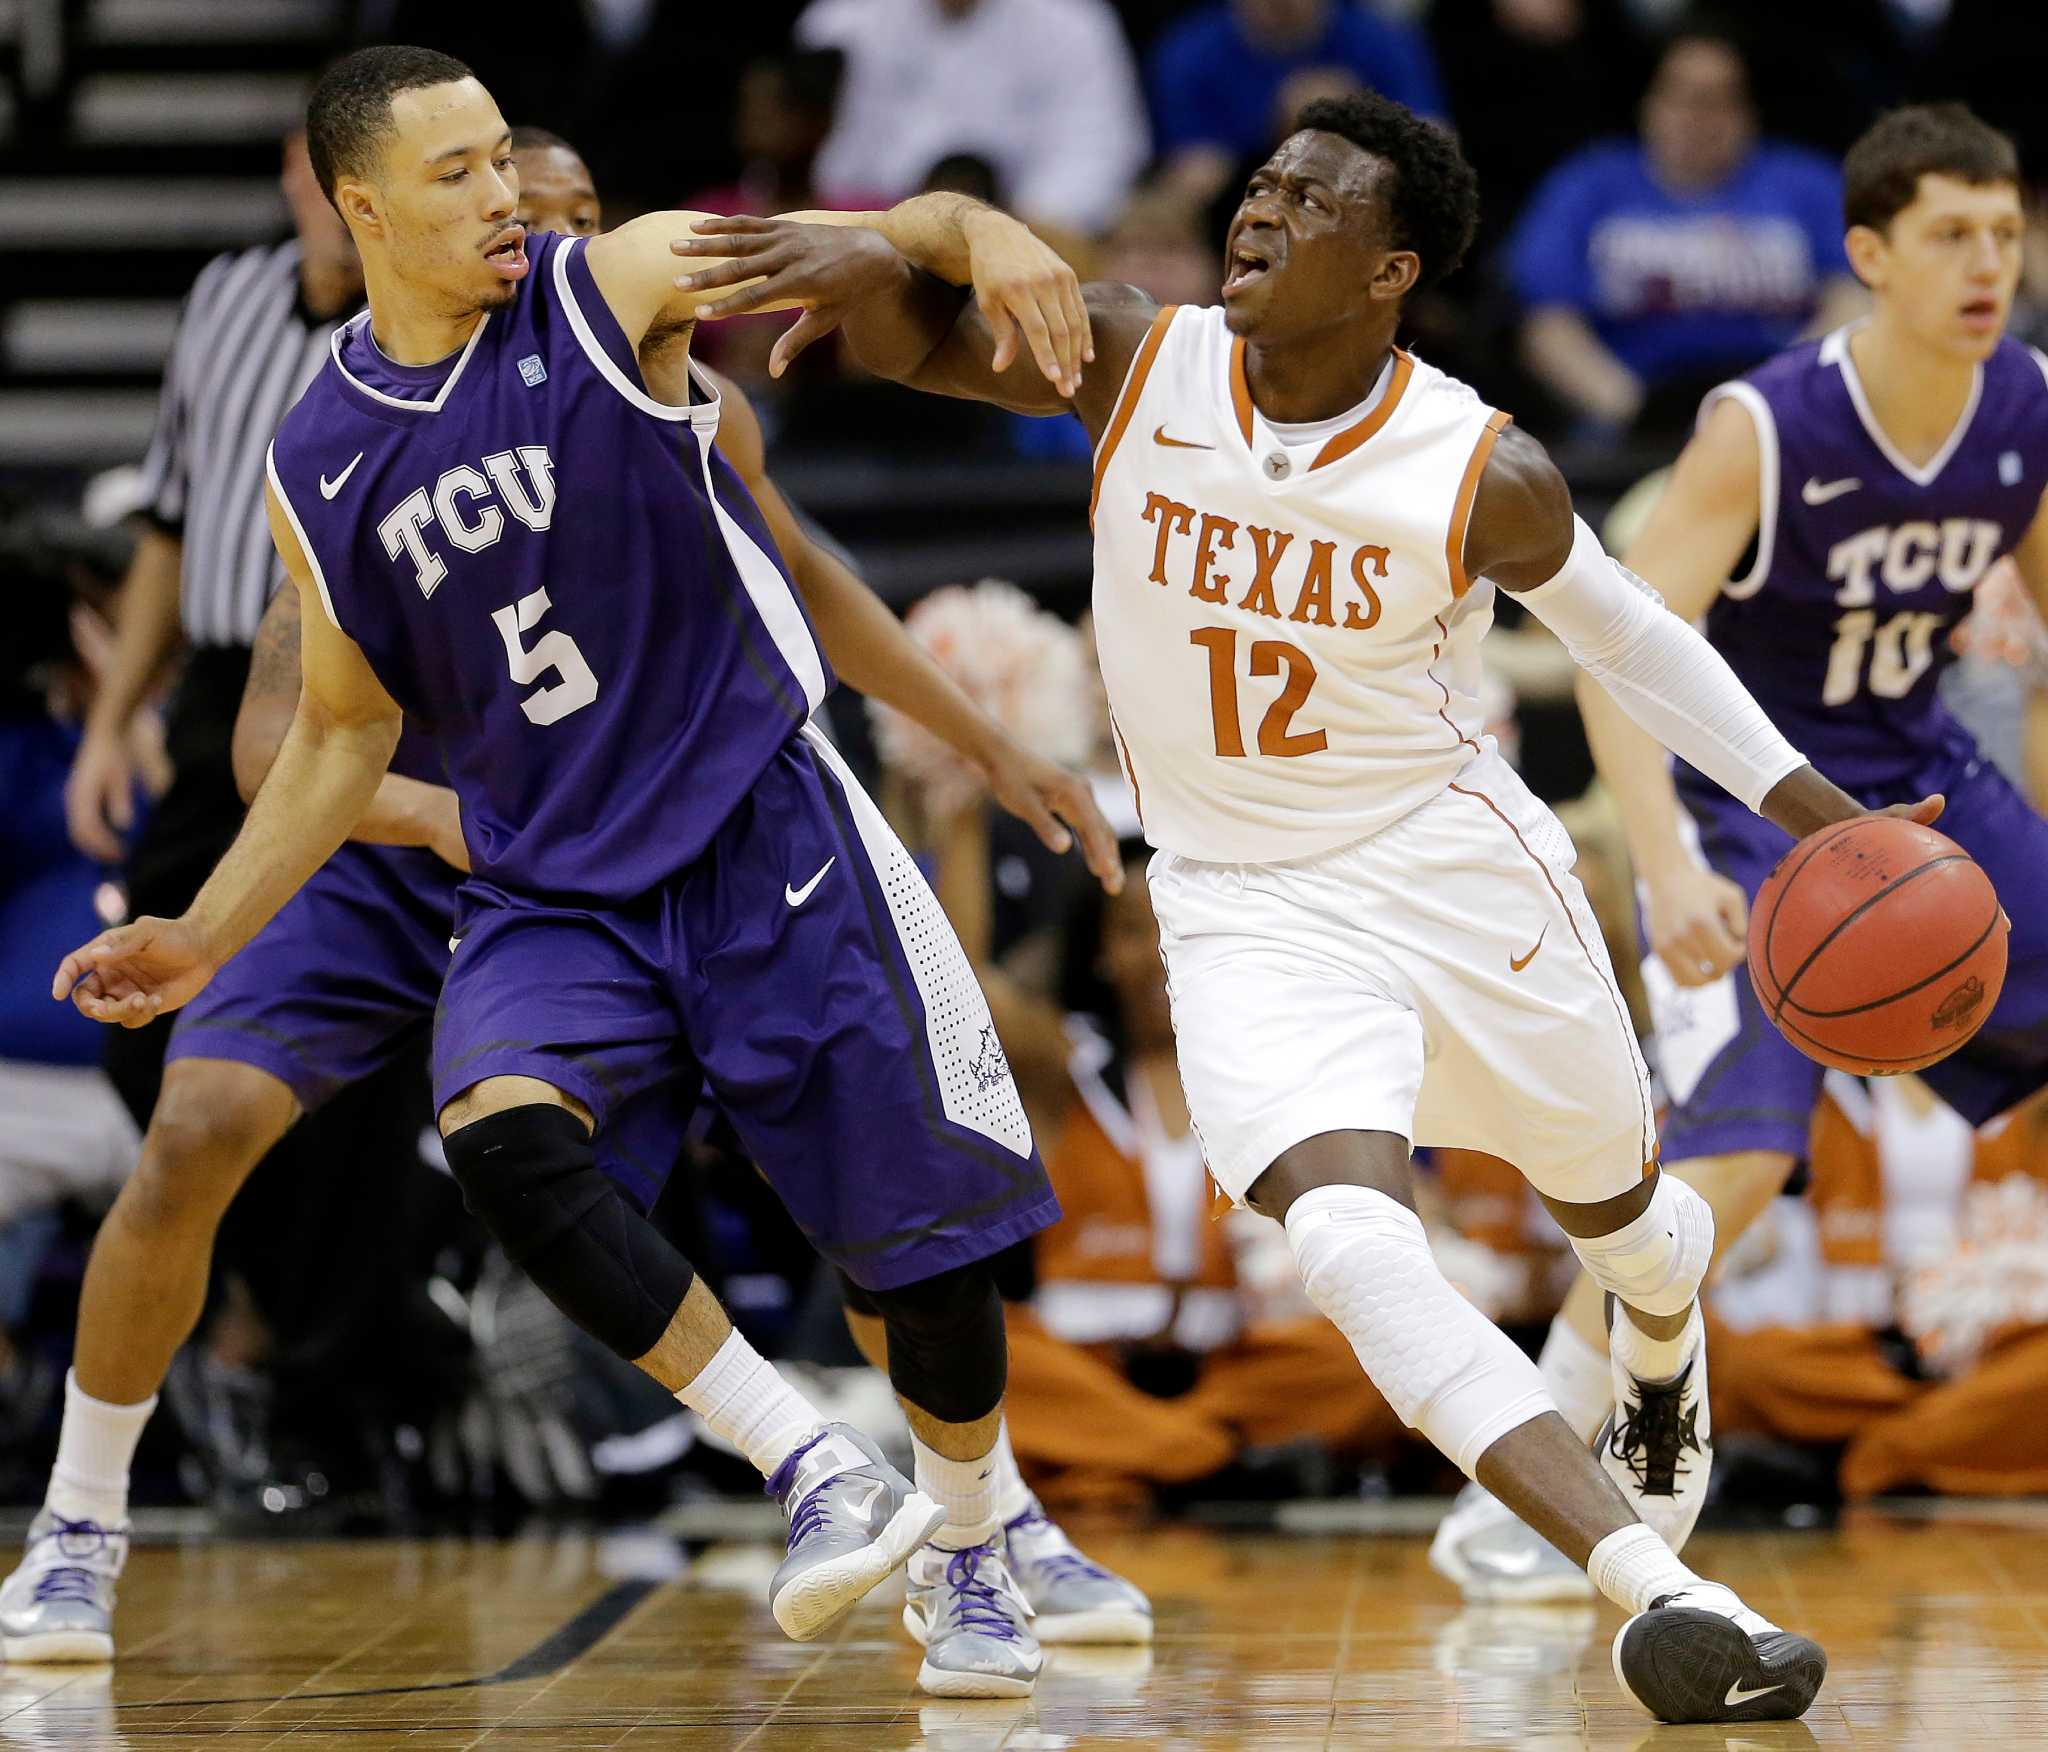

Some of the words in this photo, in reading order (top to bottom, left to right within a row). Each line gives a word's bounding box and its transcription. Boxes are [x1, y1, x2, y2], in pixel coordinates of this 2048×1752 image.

[377, 445, 557, 600] TCU
[1141, 491, 1391, 630] TEXAS
[1825, 517, 2002, 608] TCU
[491, 585, 599, 726] 5
[1190, 626, 1329, 758] 12
[1821, 608, 1946, 707] 10
